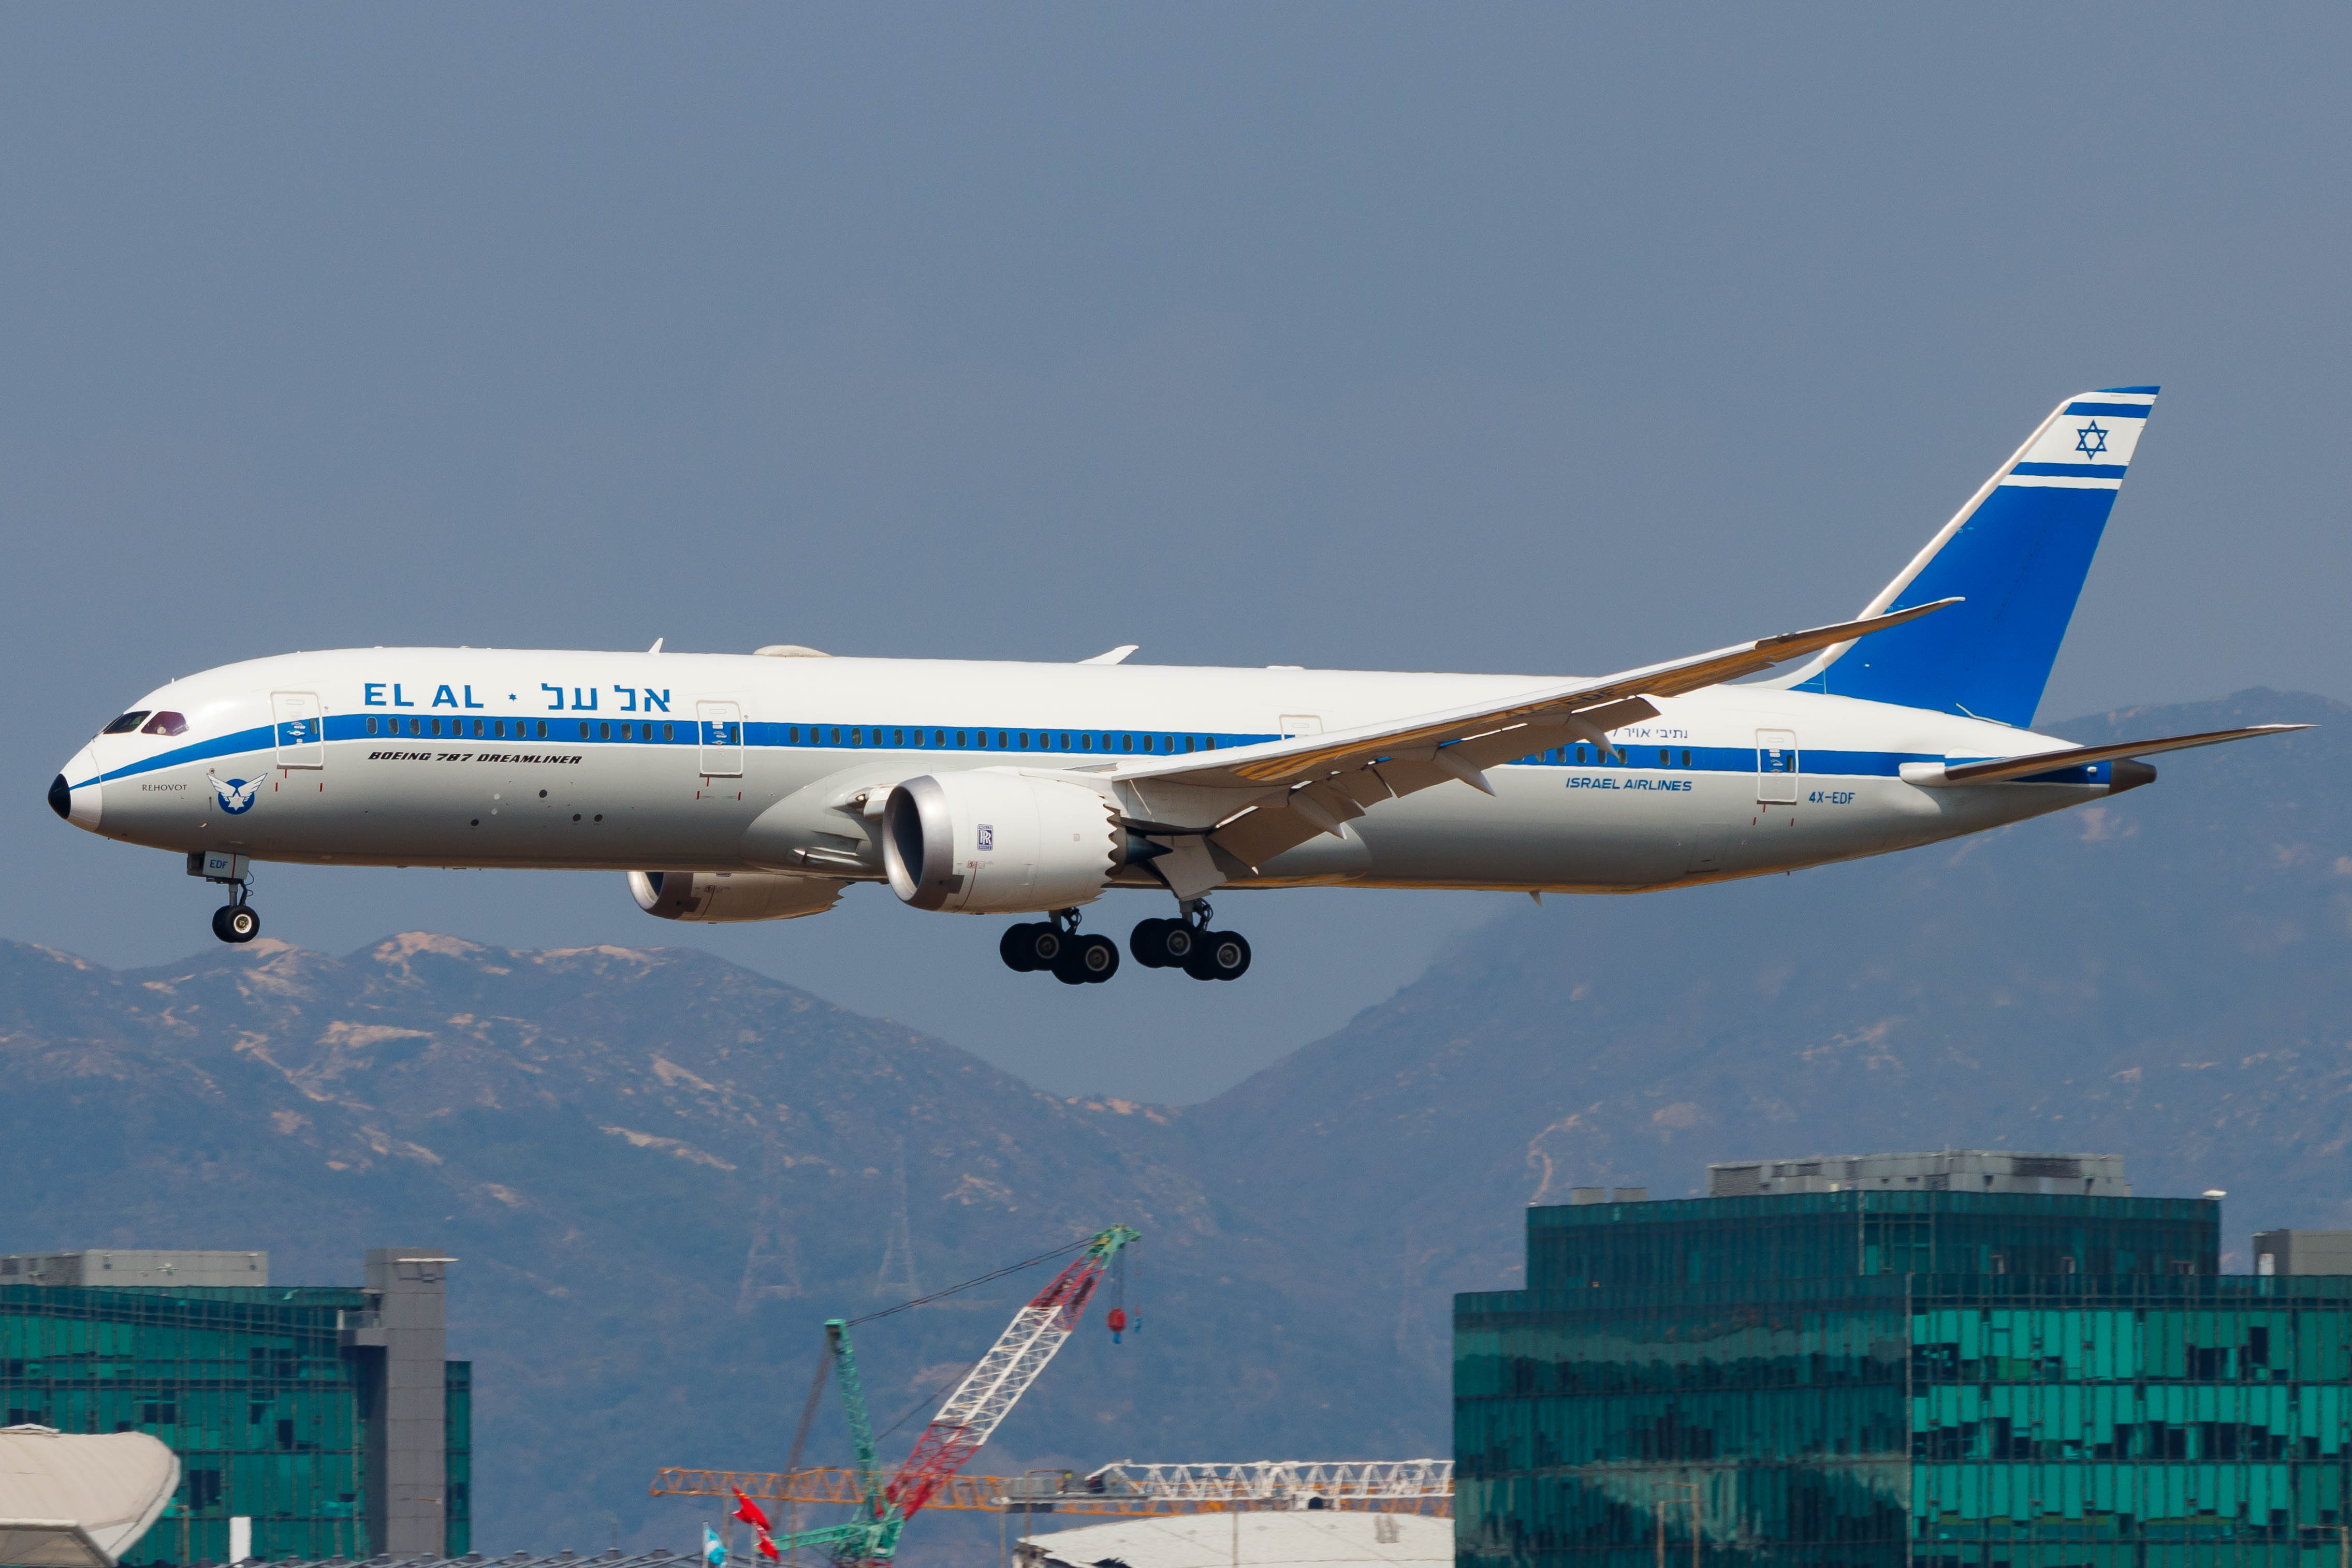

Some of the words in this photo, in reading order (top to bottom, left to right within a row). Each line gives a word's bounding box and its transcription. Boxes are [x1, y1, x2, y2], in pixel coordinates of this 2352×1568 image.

[364, 683, 414, 707] EL
[431, 684, 484, 708] AL
[541, 683, 598, 710] על
[613, 684, 671, 712] אל
[1624, 728, 1651, 738] אויר
[1656, 729, 1688, 739] נתיבי
[368, 752, 432, 761] BOEING
[435, 753, 474, 762] 787
[476, 754, 582, 764] DREAMLINER
[1566, 777, 1620, 789] ISRAEL
[1623, 779, 1692, 791] AIRLINES
[1808, 791, 1856, 804] 4X-EDF
[209, 859, 228, 869] EDF
